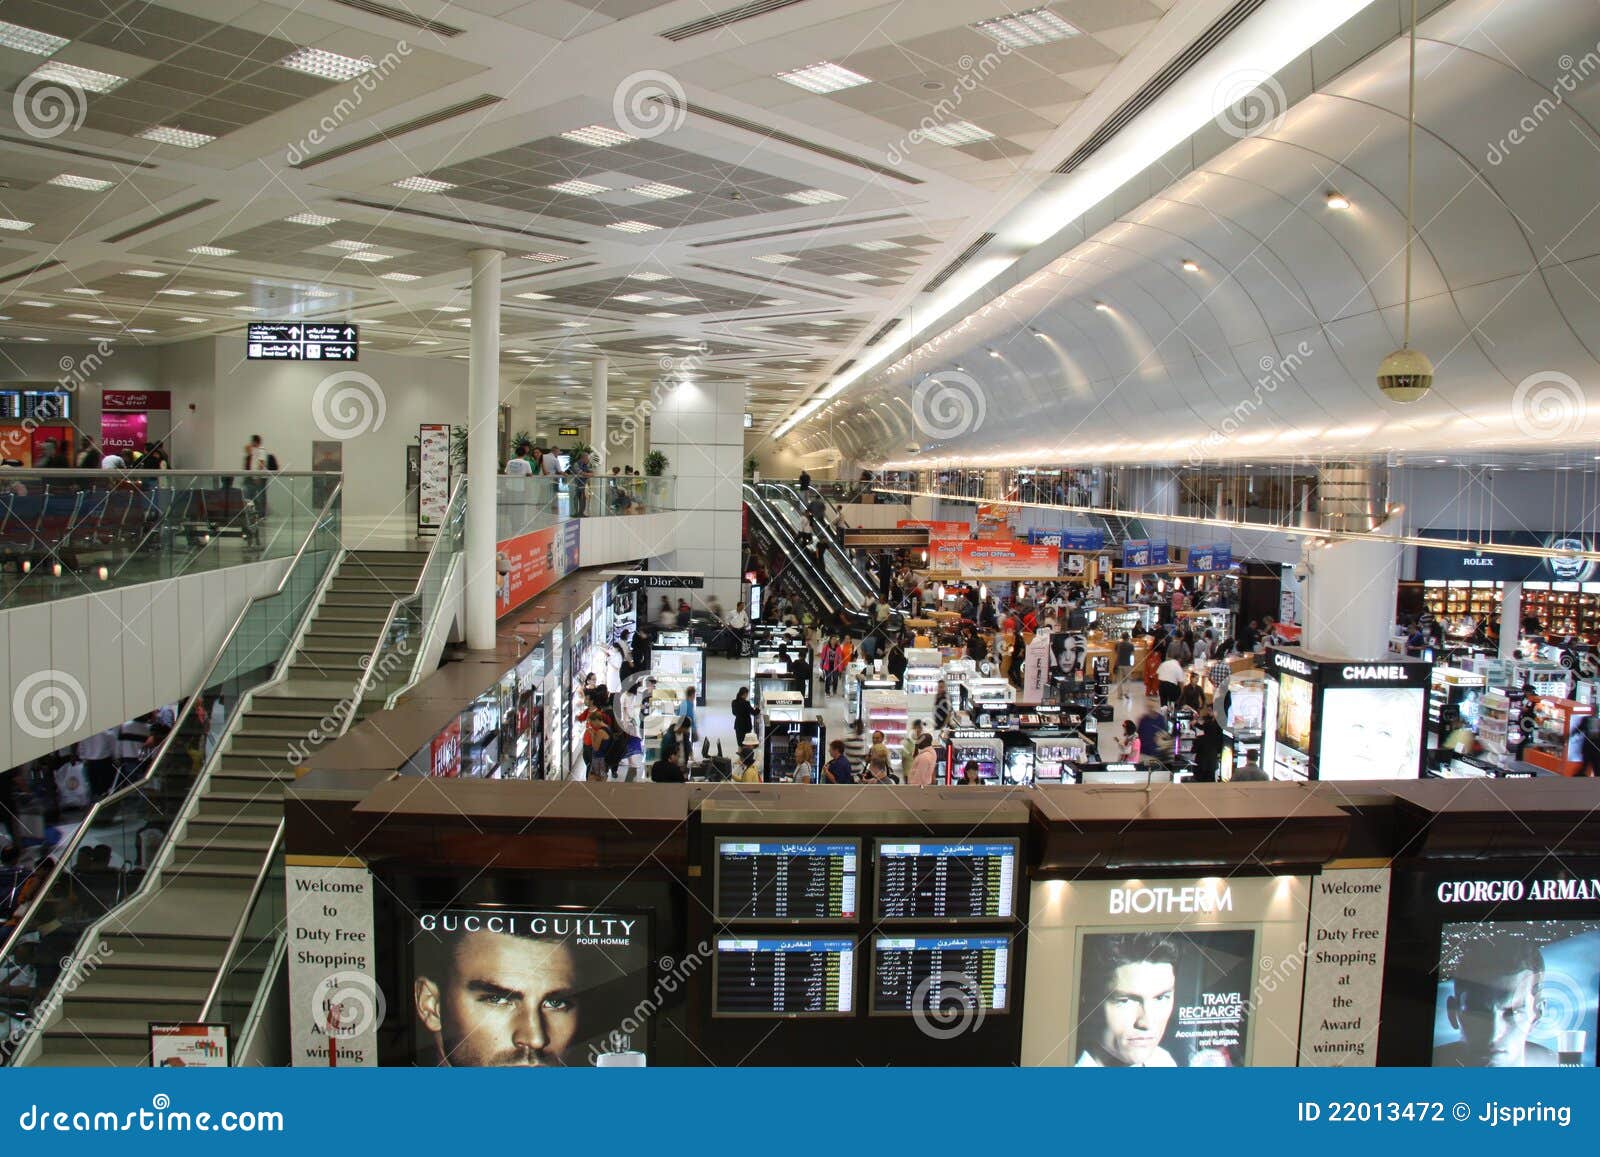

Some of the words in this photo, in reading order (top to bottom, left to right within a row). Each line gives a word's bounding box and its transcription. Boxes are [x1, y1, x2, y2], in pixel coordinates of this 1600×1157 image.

[1463, 558, 1494, 566] ROLEX
[649, 576, 673, 587] Dior
[1274, 653, 1312, 675] CHANEL
[1342, 665, 1409, 680] CHANEL
[295, 879, 364, 894] Welcome
[1320, 881, 1382, 895] Welcome
[1437, 880, 1524, 903] GIORGIO
[1109, 886, 1233, 914] BIOTHERM
[322, 904, 338, 917] to
[1343, 906, 1357, 918] to
[420, 914, 515, 934] GUCCI
[530, 918, 636, 936] GUILTY
[296, 927, 330, 944] Duty
[335, 928, 366, 942] Free
[576, 937, 598, 945] POUR
[600, 938, 630, 946] HOMME
[1316, 928, 1348, 943] Duty
[1352, 927, 1380, 940] Free
[298, 951, 366, 970] Shopping
[1315, 950, 1377, 967] Shopping
[325, 977, 339, 989] at
[1338, 974, 1351, 986] at
[1202, 992, 1243, 1005] TRAVEL
[1331, 995, 1353, 1009] the
[1179, 1005, 1242, 1018] RECHARGE
[1319, 1017, 1362, 1032] Award
[1313, 1040, 1365, 1056] winning
